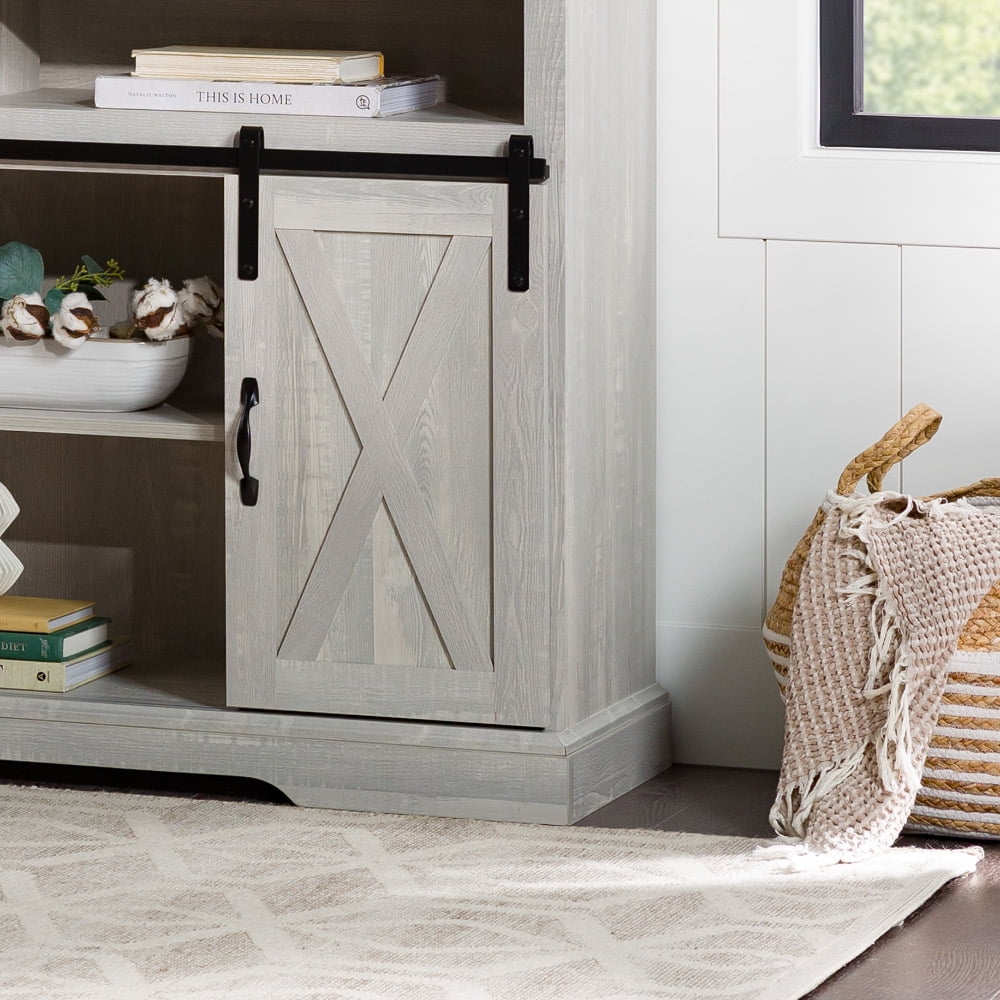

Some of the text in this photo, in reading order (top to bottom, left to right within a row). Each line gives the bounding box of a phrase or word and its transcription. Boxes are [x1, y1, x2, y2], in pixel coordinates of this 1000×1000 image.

[196, 91, 293, 105] THIS IS HOME
[1, 642, 28, 652] DIET
